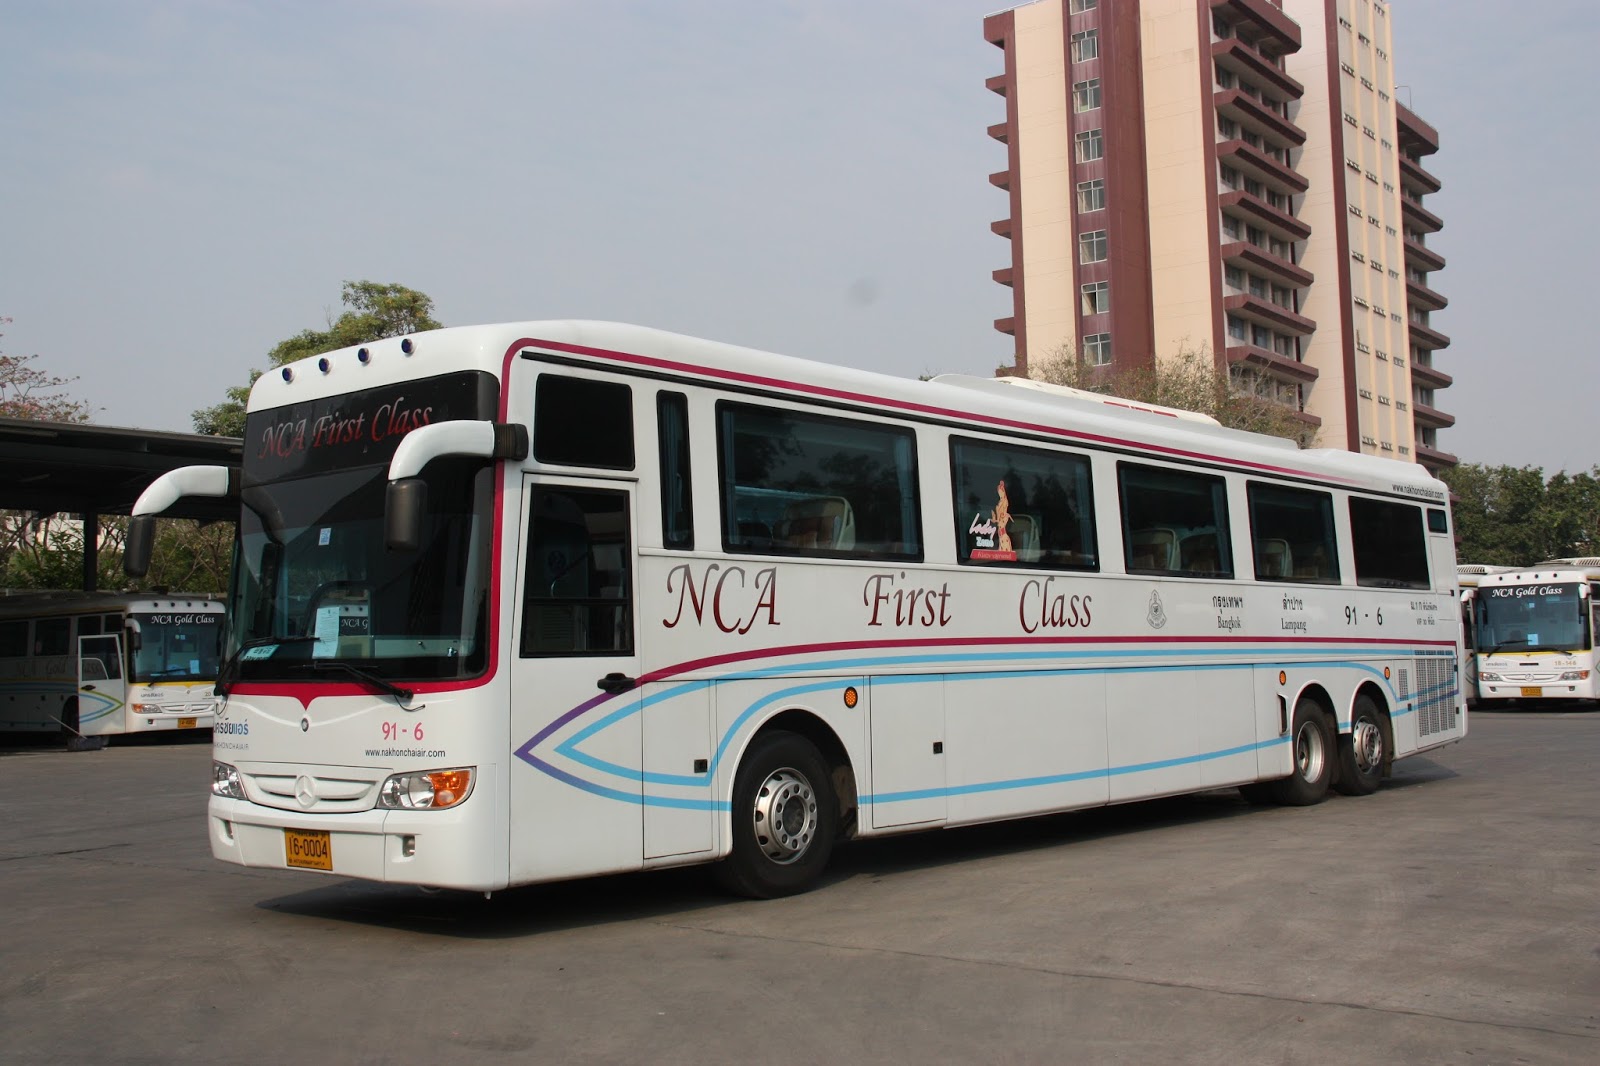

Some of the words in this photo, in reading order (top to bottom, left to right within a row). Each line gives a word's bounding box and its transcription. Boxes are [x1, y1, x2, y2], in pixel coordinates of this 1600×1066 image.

[258, 418, 306, 460] NCA
[313, 410, 366, 448] First
[371, 397, 433, 442] Class
[969, 512, 997, 541] Lady
[662, 563, 781, 635] NCA
[863, 571, 952, 627] First
[1019, 576, 1093, 634] Class
[1492, 588, 1513, 598] NCA
[1515, 586, 1538, 598] Gold
[1539, 585, 1563, 596] Class
[151, 615, 172, 625] NCA
[174, 614, 194, 626] Gold
[195, 615, 215, 625] Class
[341, 618, 360, 628] NCA
[1217, 615, 1242, 633] Bangkok
[1281, 617, 1307, 634] Lampang
[1345, 605, 1358, 626] 91
[1376, 606, 1383, 626] 6
[214, 717, 249, 735] ครชัยแอร์
[381, 721, 397, 741] 91
[414, 721, 424, 741] 6
[364, 747, 446, 758] www.nakhonchaiair.com
